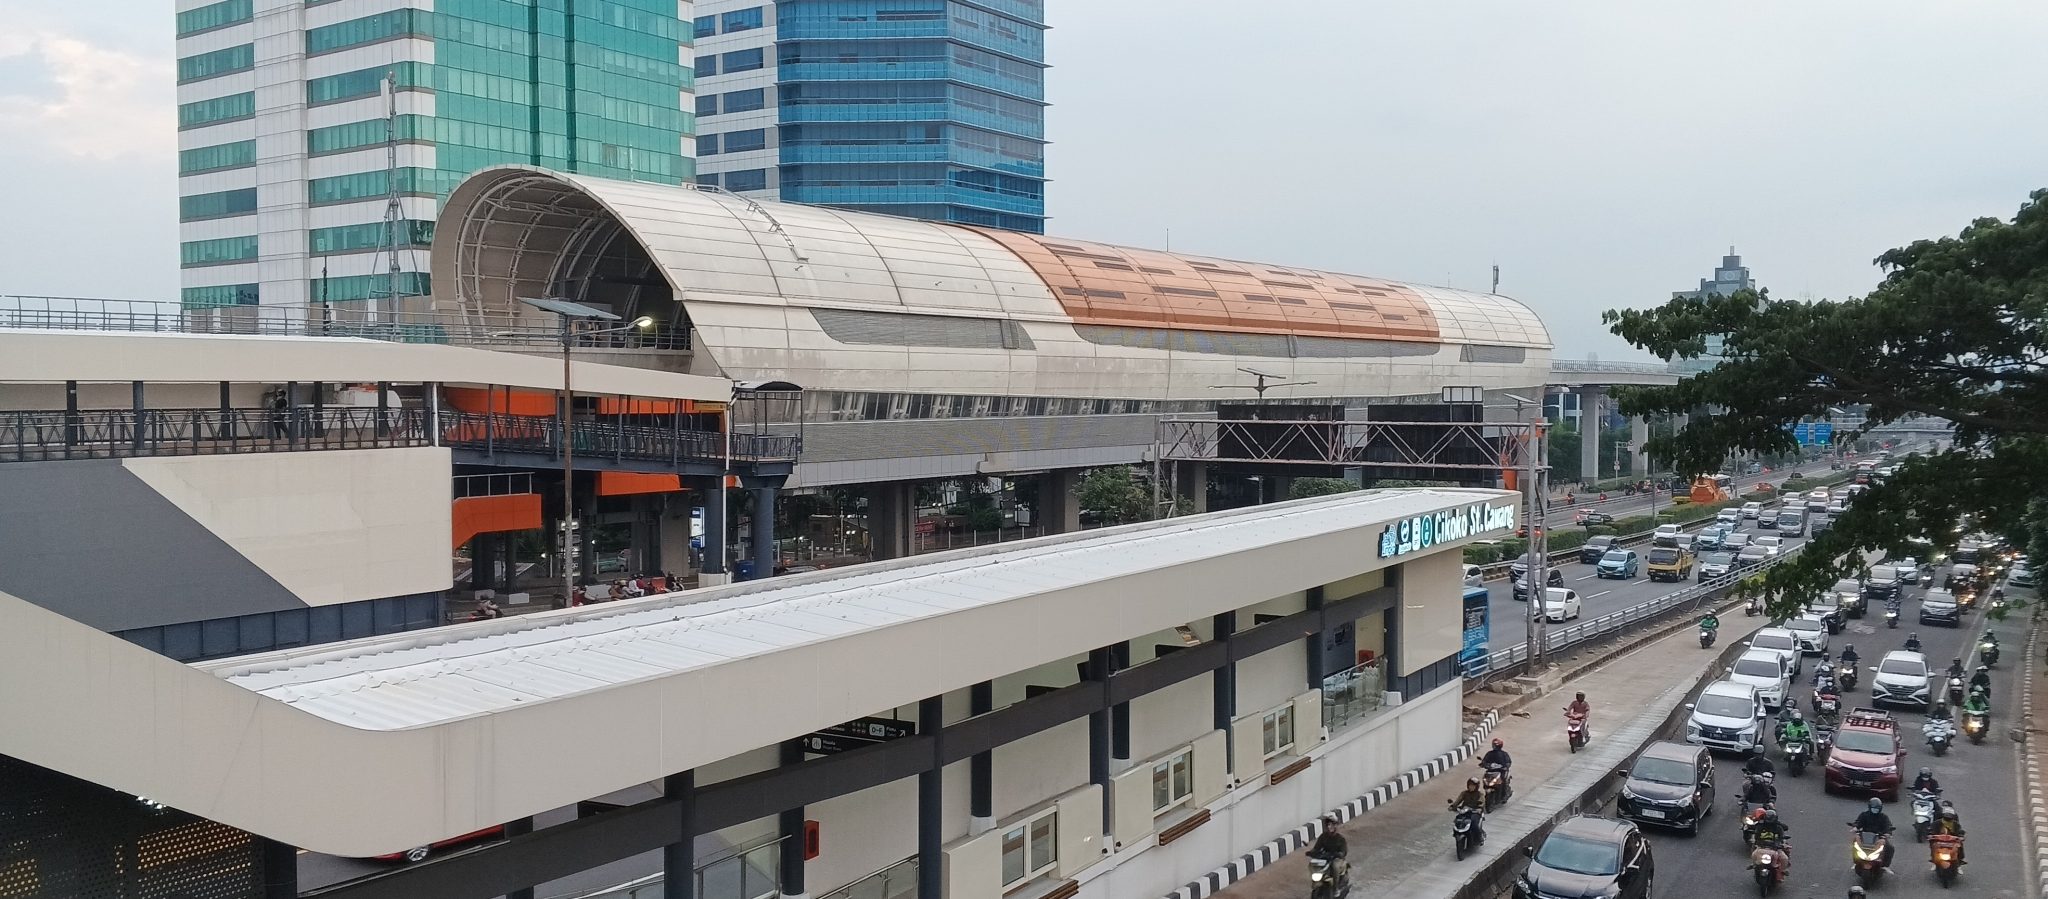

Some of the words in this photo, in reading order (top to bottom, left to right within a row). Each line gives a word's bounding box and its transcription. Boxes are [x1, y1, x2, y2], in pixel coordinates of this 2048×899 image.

[1435, 509, 1468, 544] Cikoko
[1470, 505, 1484, 536] St.
[1484, 503, 1515, 530] Cawang
